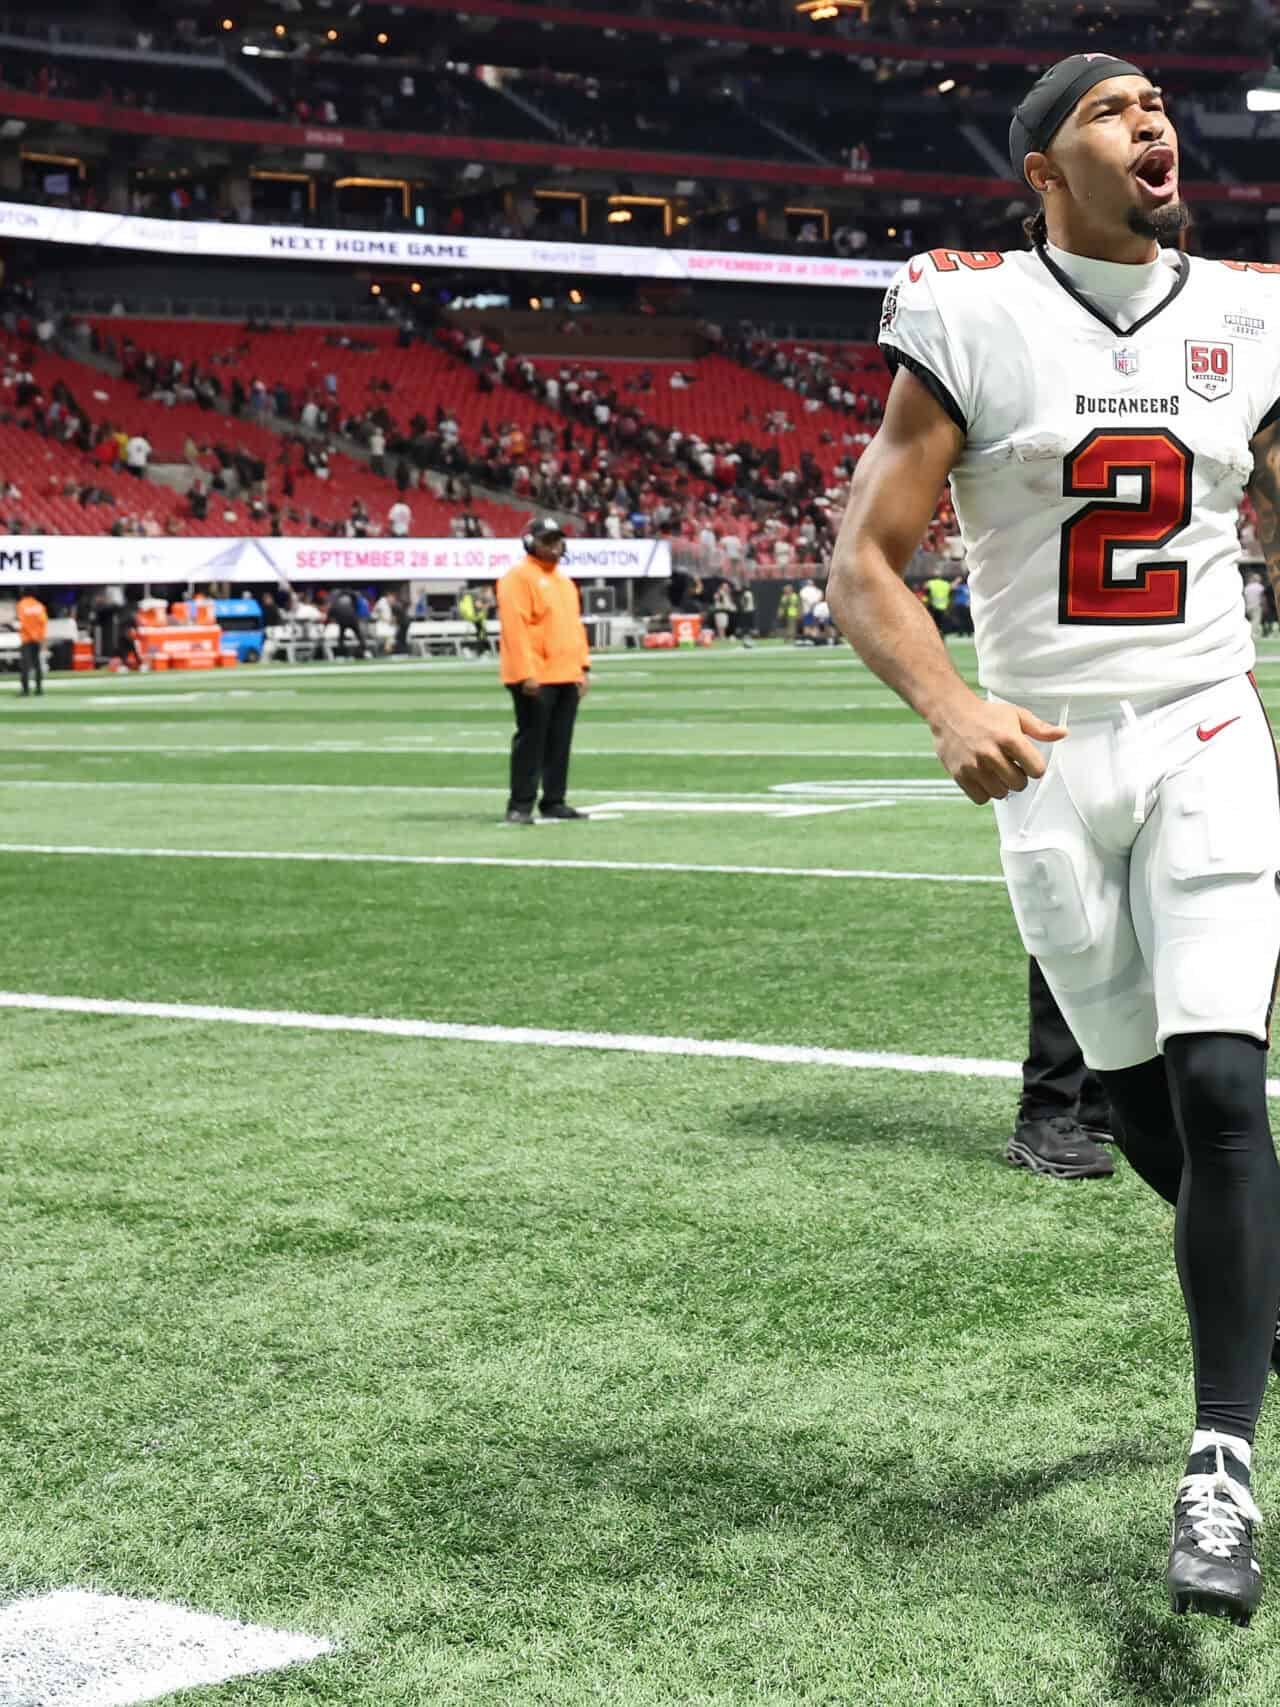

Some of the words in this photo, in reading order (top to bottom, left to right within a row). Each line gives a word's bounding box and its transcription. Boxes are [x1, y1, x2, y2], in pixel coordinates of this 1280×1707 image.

[270, 234, 326, 250] NEXT
[335, 238, 400, 255] HOME
[407, 242, 469, 258] GAME
[688, 256, 773, 272] SEPTEMBER
[1191, 346, 1228, 375] 50
[1075, 395, 1179, 417] BUCCANEERS
[1058, 427, 1194, 625] 2
[295, 550, 405, 569] SEPTEMBER
[411, 551, 429, 567] 28
[434, 552, 448, 567] at
[452, 551, 485, 567] 1:00
[488, 554, 511, 571] pm
